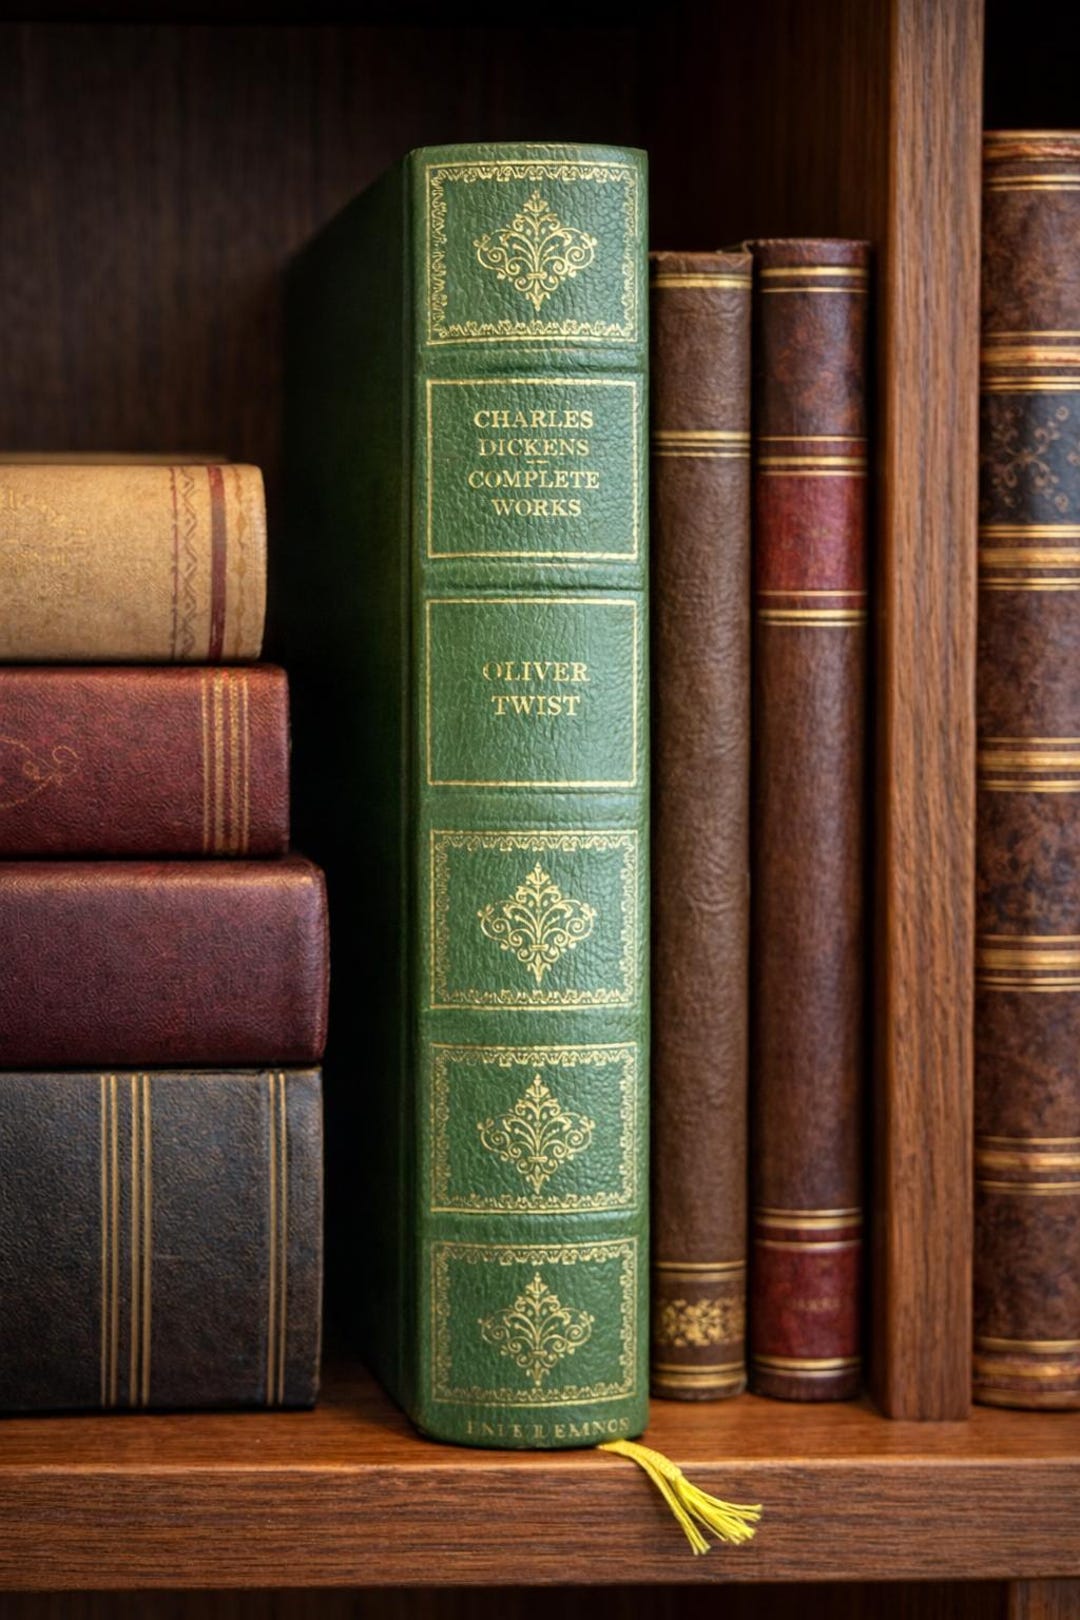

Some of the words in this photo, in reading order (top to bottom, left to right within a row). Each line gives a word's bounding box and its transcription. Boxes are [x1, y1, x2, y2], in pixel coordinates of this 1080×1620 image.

[474, 410, 594, 428] CHARLES
[479, 438, 590, 456] DICKENS
[468, 471, 600, 488] COMPLETE
[492, 499, 582, 516] WORKS
[482, 661, 591, 681] OLIVER
[491, 695, 580, 715] TWIST
